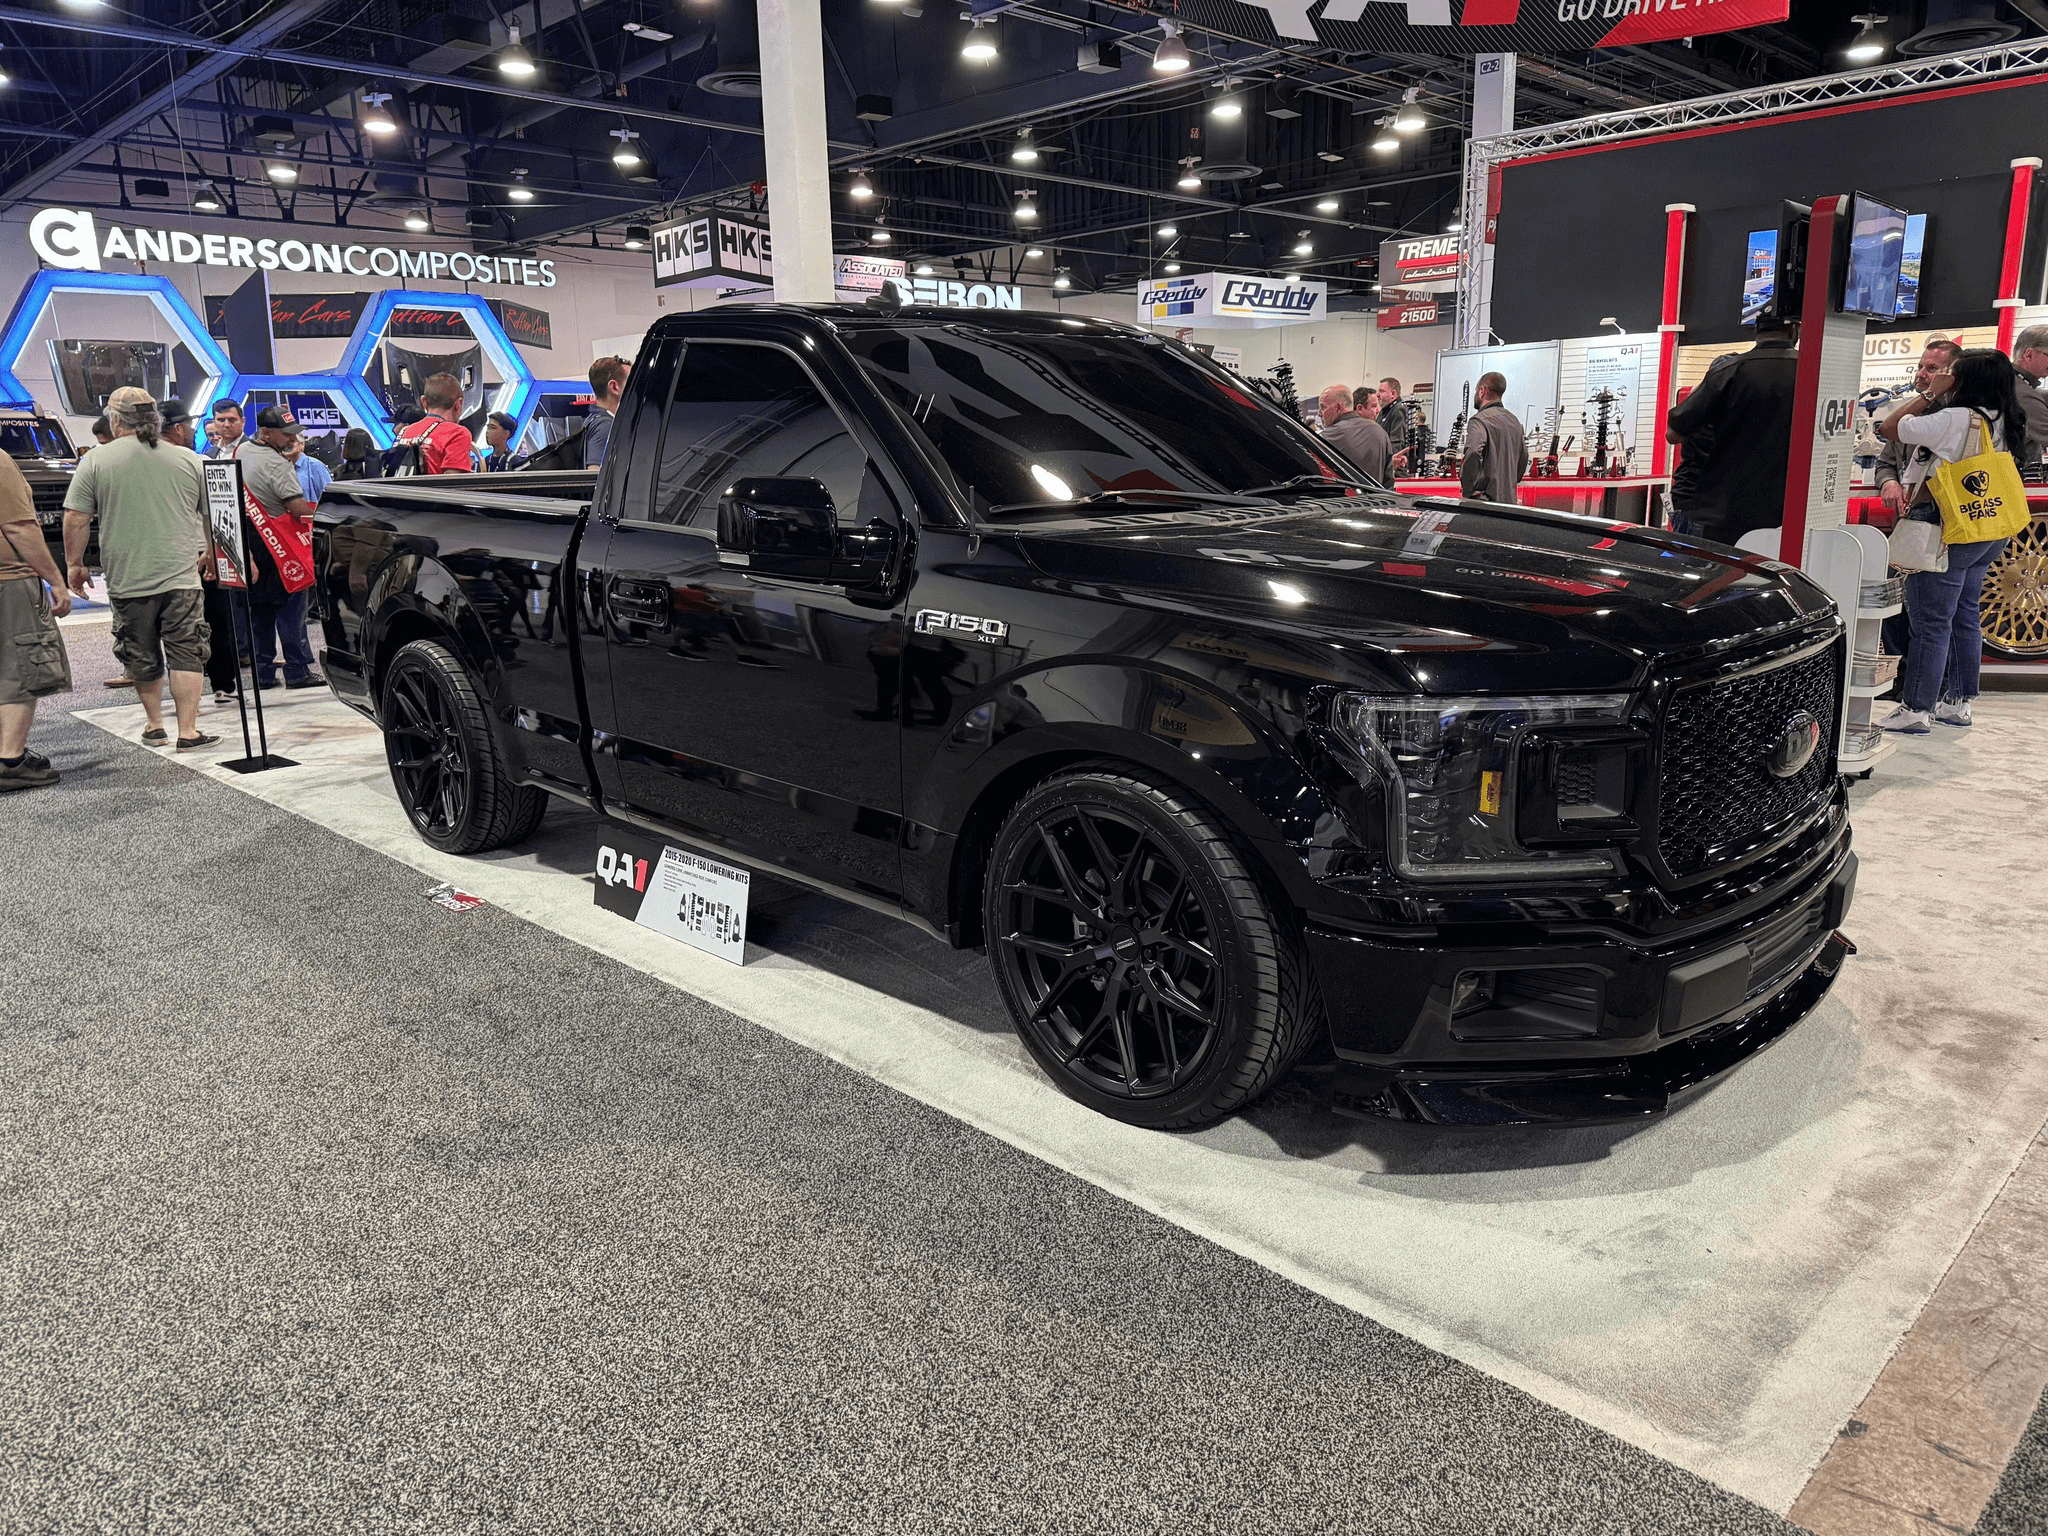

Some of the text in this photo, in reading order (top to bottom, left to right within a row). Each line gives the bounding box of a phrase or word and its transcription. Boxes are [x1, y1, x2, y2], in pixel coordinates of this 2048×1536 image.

[1481, 60, 1500, 73] C2-2
[656, 222, 709, 263] HKS
[720, 223, 772, 261] HKS
[1141, 285, 1208, 306] GReddy
[1221, 279, 1319, 311] GReddy
[1405, 288, 1433, 302] 21500
[1399, 309, 1436, 324] 21500
[299, 409, 340, 420] HKS
[1825, 399, 1855, 436] QA1
[207, 468, 227, 480] ENTER
[208, 481, 218, 492] TO
[1959, 497, 2003, 514] BIG ASS
[1968, 508, 1997, 521] FANS
[977, 635, 998, 644] XLT
[596, 845, 649, 893] QA1
[664, 849, 749, 885] 2015-2020 F-150 LOWERING KITS
